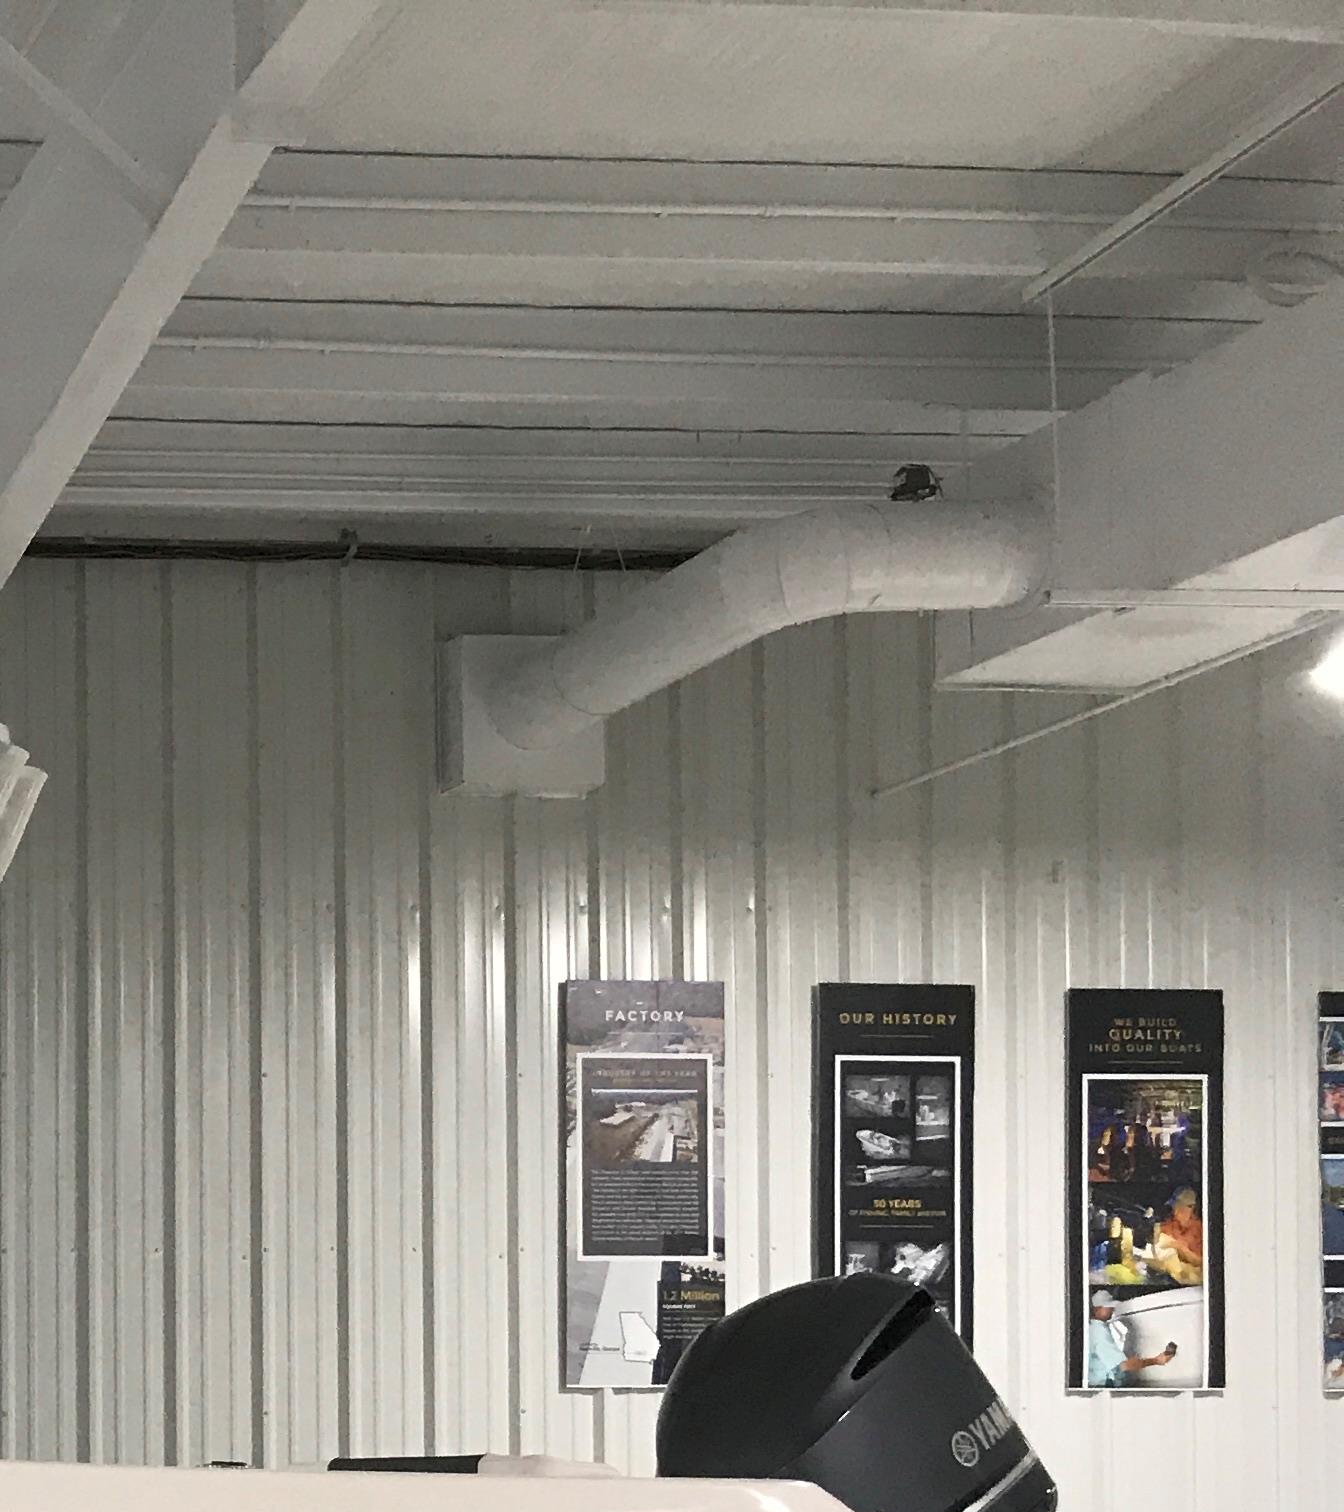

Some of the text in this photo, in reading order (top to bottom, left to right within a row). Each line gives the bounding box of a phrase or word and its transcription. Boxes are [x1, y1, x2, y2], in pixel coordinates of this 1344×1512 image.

[605, 1010, 684, 1022] FACTORY
[839, 1013, 957, 1025] OUR HISTORY
[1114, 1018, 1177, 1027] WE BUILD
[1109, 1029, 1181, 1041] QUALITY
[1089, 1043, 1202, 1053] INTO OUR BOATS
